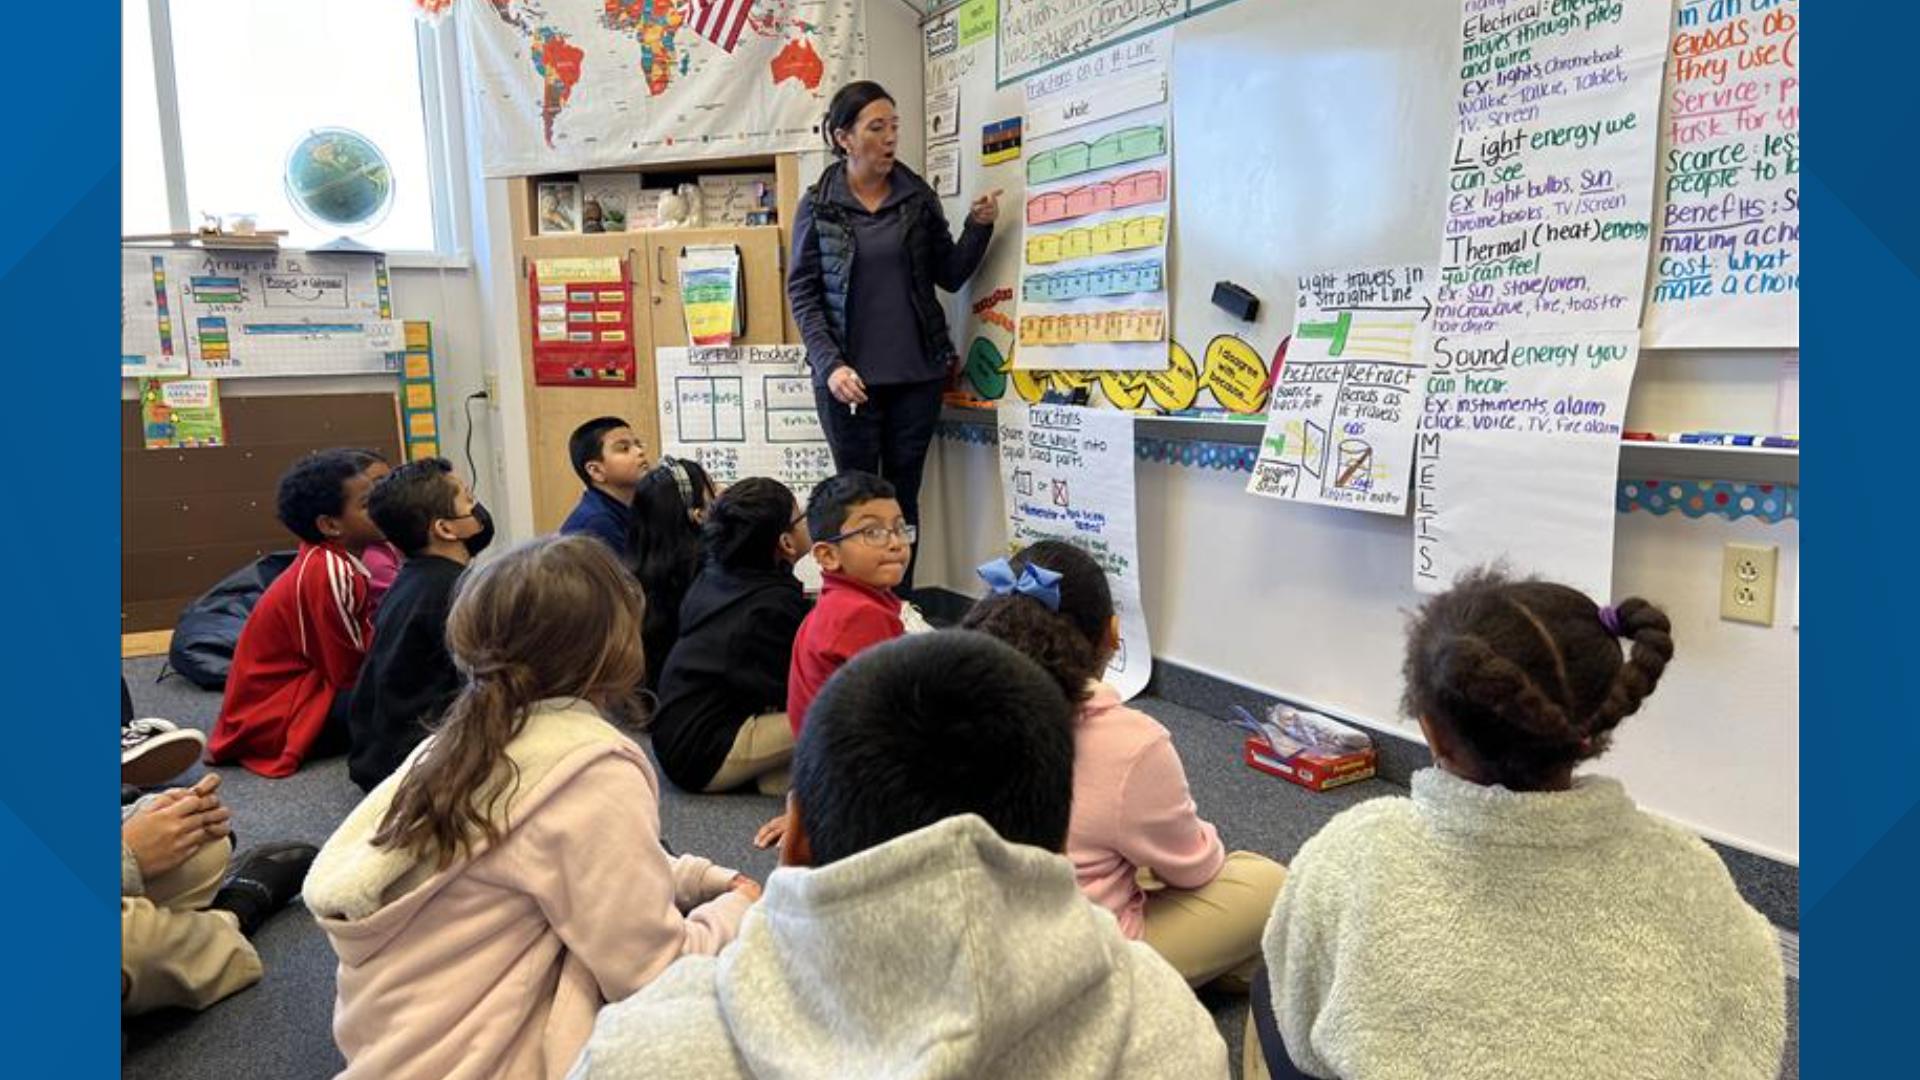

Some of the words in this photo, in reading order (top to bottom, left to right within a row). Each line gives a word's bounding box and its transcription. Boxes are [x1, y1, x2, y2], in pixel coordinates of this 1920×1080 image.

[1678, 8, 1698, 26] in
[1463, 33, 1510, 61] moves
[1517, 14, 1579, 44] through
[1461, 57, 1491, 78] and
[1495, 48, 1532, 69] wires
[1738, 45, 1780, 70] use
[1452, 129, 1527, 166] Light
[1530, 120, 1602, 151] energy
[1606, 112, 1638, 135] we
[1667, 118, 1729, 145] task
[1738, 106, 1769, 131] for
[1450, 172, 1485, 192] can
[1490, 163, 1525, 184] see
[1666, 168, 1740, 202] people
[1751, 160, 1777, 181] to
[1483, 183, 1525, 212] light
[1447, 228, 1528, 263] Thermal
[1601, 219, 1650, 244] energy
[1660, 233, 1737, 255] making
[1744, 228, 1759, 247] a
[1473, 263, 1503, 282] can
[1508, 252, 1541, 276] feel
[1729, 249, 1791, 272] what
[1567, 294, 1628, 312] toaster
[1654, 279, 1714, 303] make
[1721, 275, 1737, 294] a
[1434, 337, 1509, 369] Sound
[1511, 344, 1579, 368] energy
[1587, 345, 1628, 369] you
[1426, 378, 1456, 394] can
[1553, 396, 1606, 416] alarm
[1584, 417, 1621, 434] alarm
